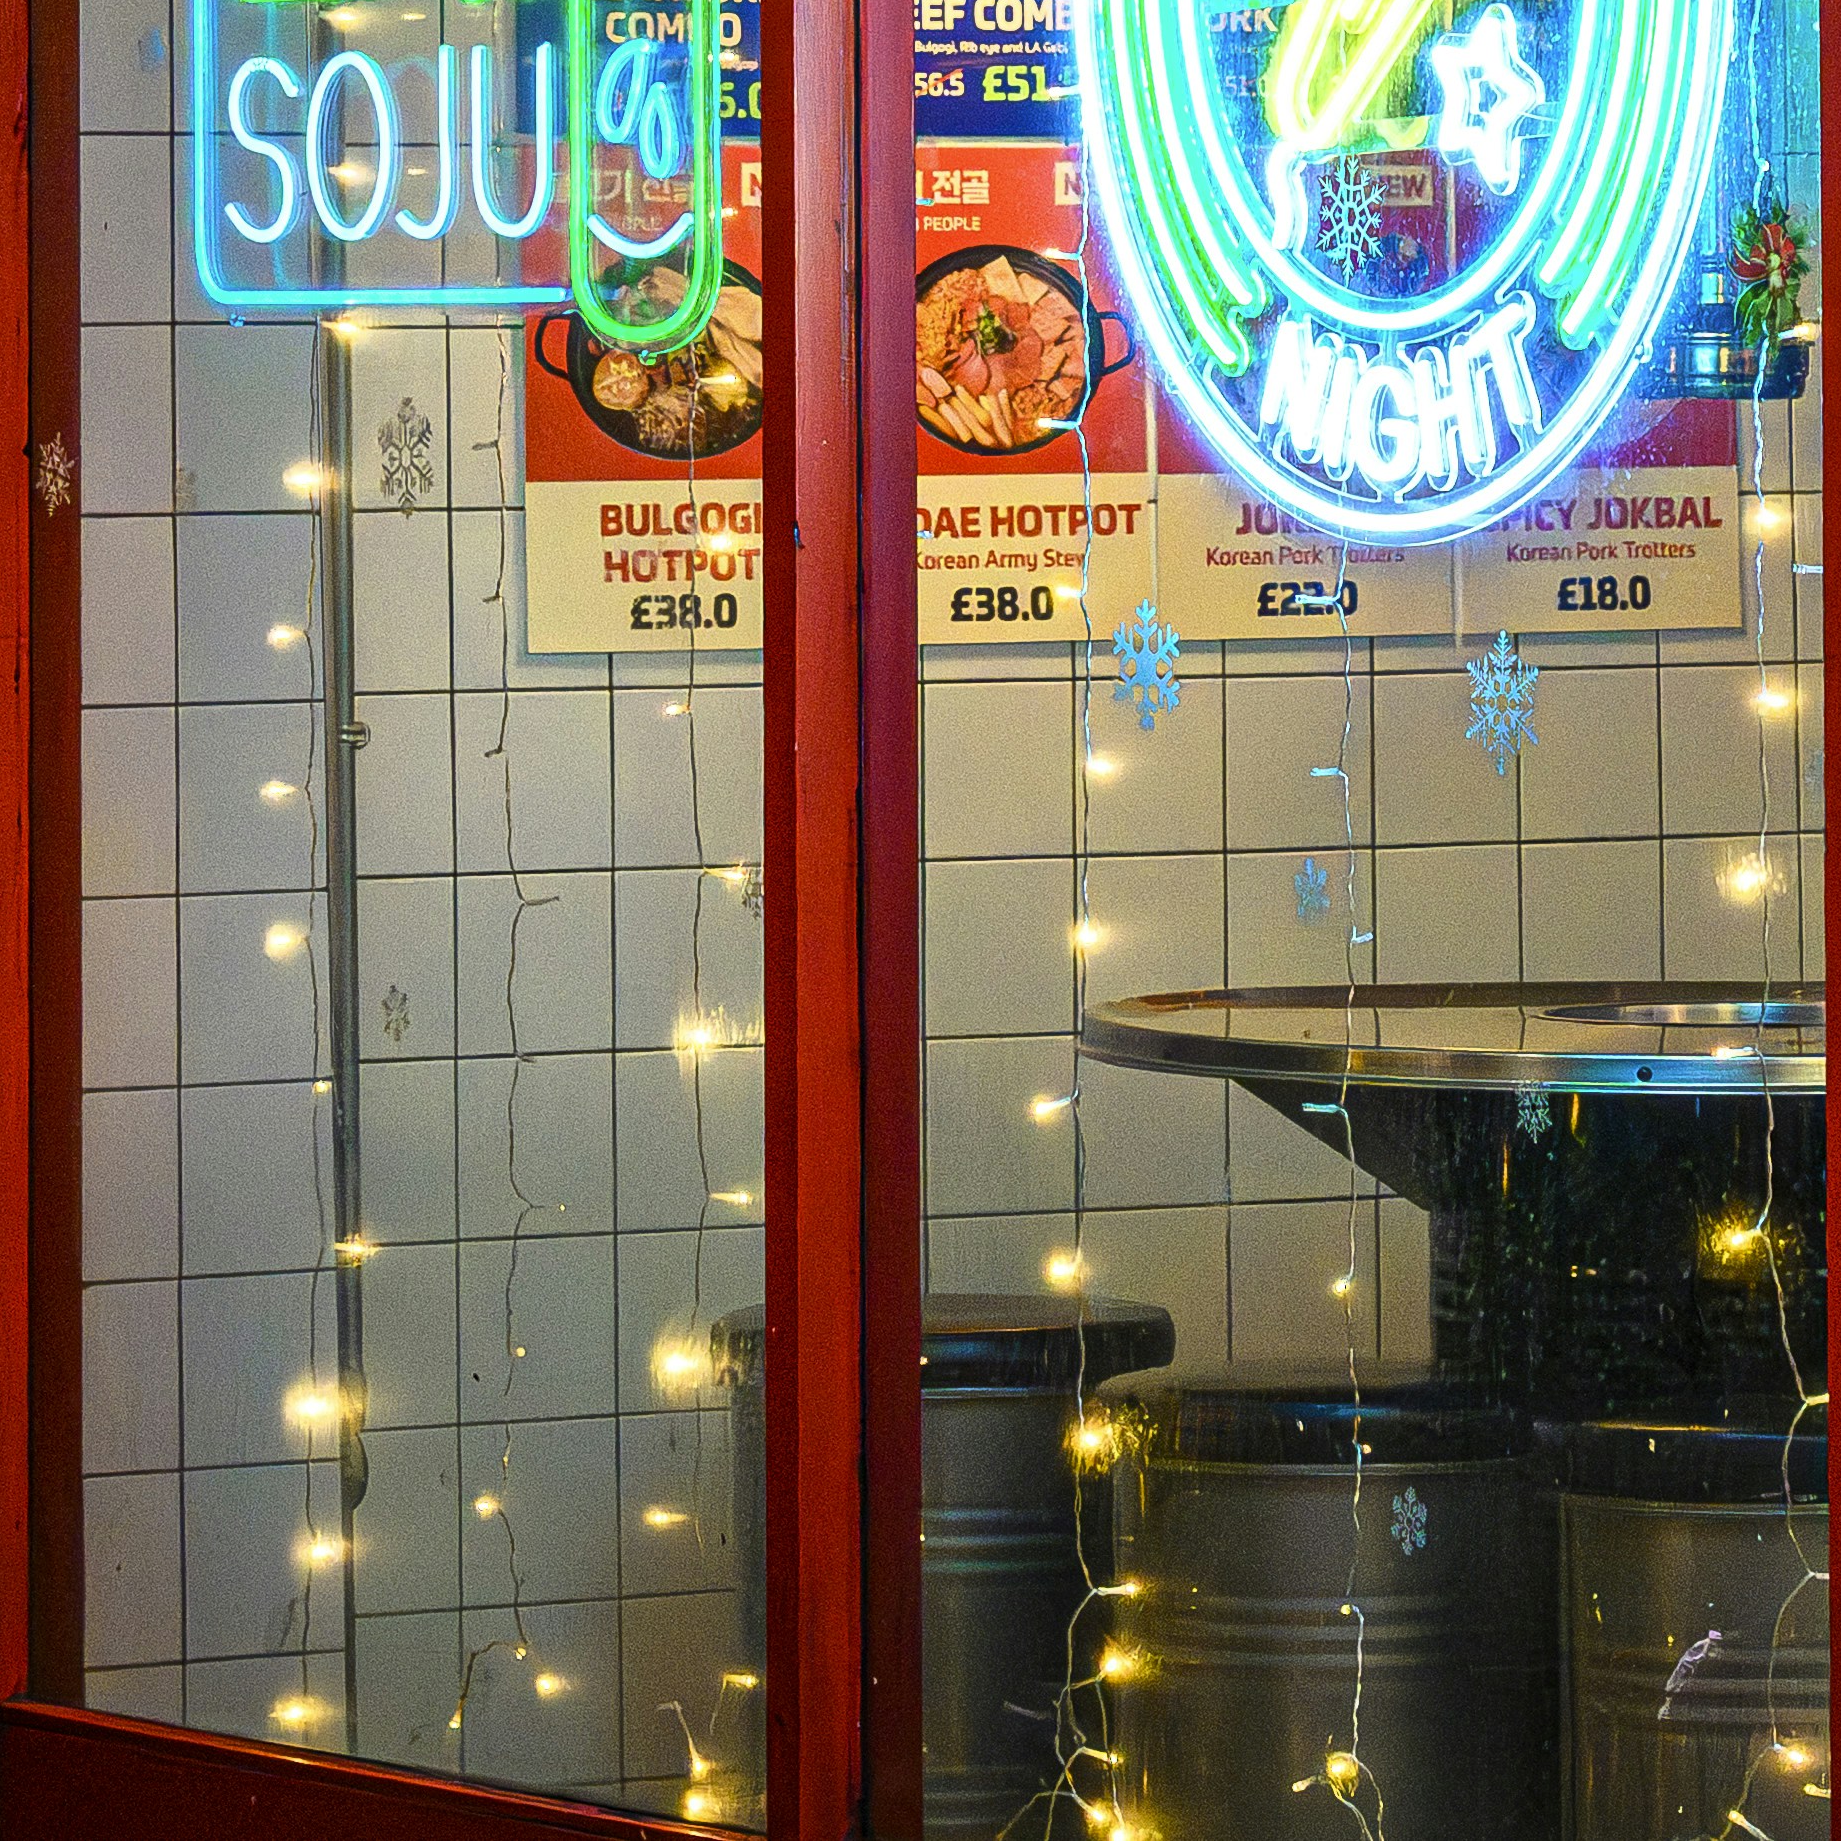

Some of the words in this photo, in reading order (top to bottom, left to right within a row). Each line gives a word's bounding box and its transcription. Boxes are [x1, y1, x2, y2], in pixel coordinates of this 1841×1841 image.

[605, 11, 742, 47] COMO
[1025, 41, 1042, 54] LA
[914, 70, 965, 97] 56.5
[225, 42, 553, 242] SOJU
[931, 169, 990, 205] 전골
[923, 216, 982, 232] PEOPLE
[1261, 298, 1542, 492] NIGHT
[600, 502, 762, 536] BULGOGI
[916, 505, 982, 539] DAE
[989, 503, 1142, 539] HOTPOT
[1484, 498, 1577, 532] PICY
[1587, 495, 1724, 530] JOKBAL
[603, 548, 761, 583] HOTPOT
[984, 549, 1038, 572] Army
[1205, 546, 1274, 568] Korean
[1278, 545, 1325, 565] Pork
[1506, 543, 1572, 563] Korean
[1576, 542, 1619, 561] Pork
[1622, 540, 1697, 560] Trotters
[950, 586, 1055, 622] £38.0
[1557, 574, 1652, 612] £18.0
[630, 593, 738, 630] £38.0
